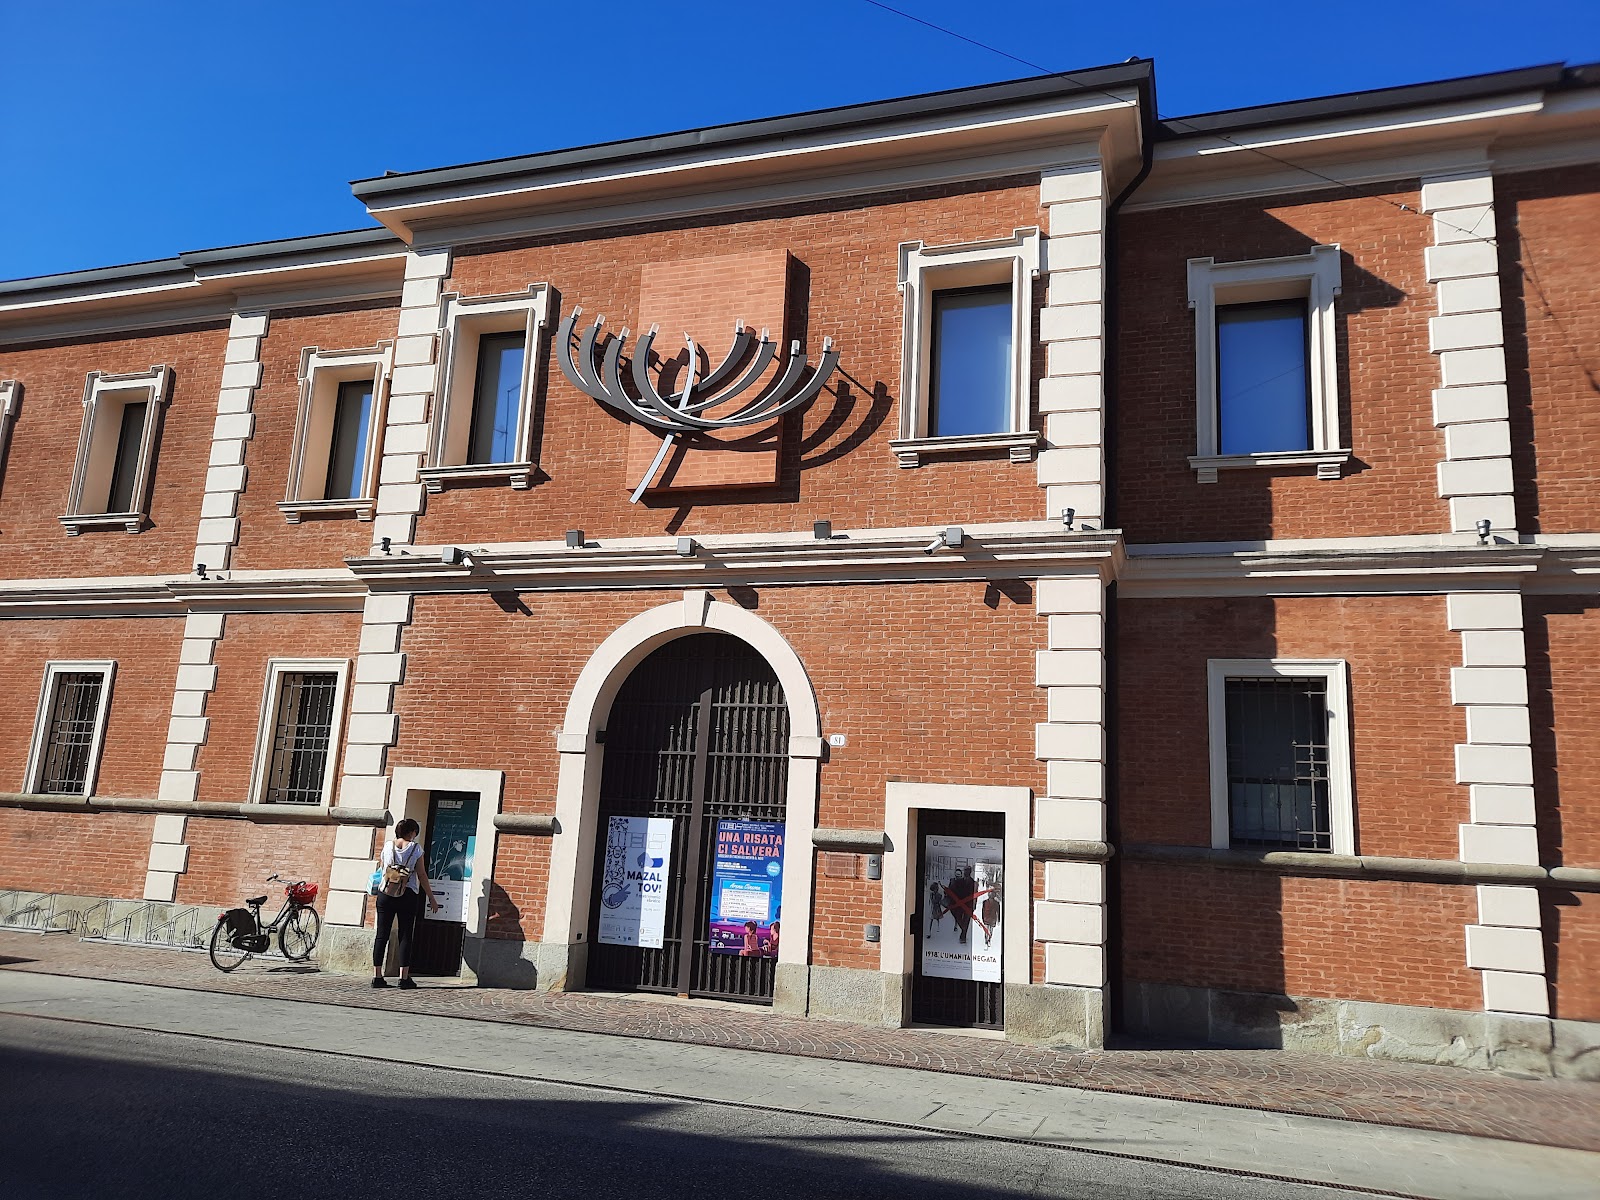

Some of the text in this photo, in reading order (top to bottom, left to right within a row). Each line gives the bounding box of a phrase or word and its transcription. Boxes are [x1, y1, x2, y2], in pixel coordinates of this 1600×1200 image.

[719, 831, 783, 846] UNA RISATA
[717, 843, 729, 854] CI
[731, 844, 780, 858] SALVERÀ
[627, 870, 662, 882] MAZAL
[637, 882, 662, 894] TOV!
[972, 954, 997, 964] NEGATA
